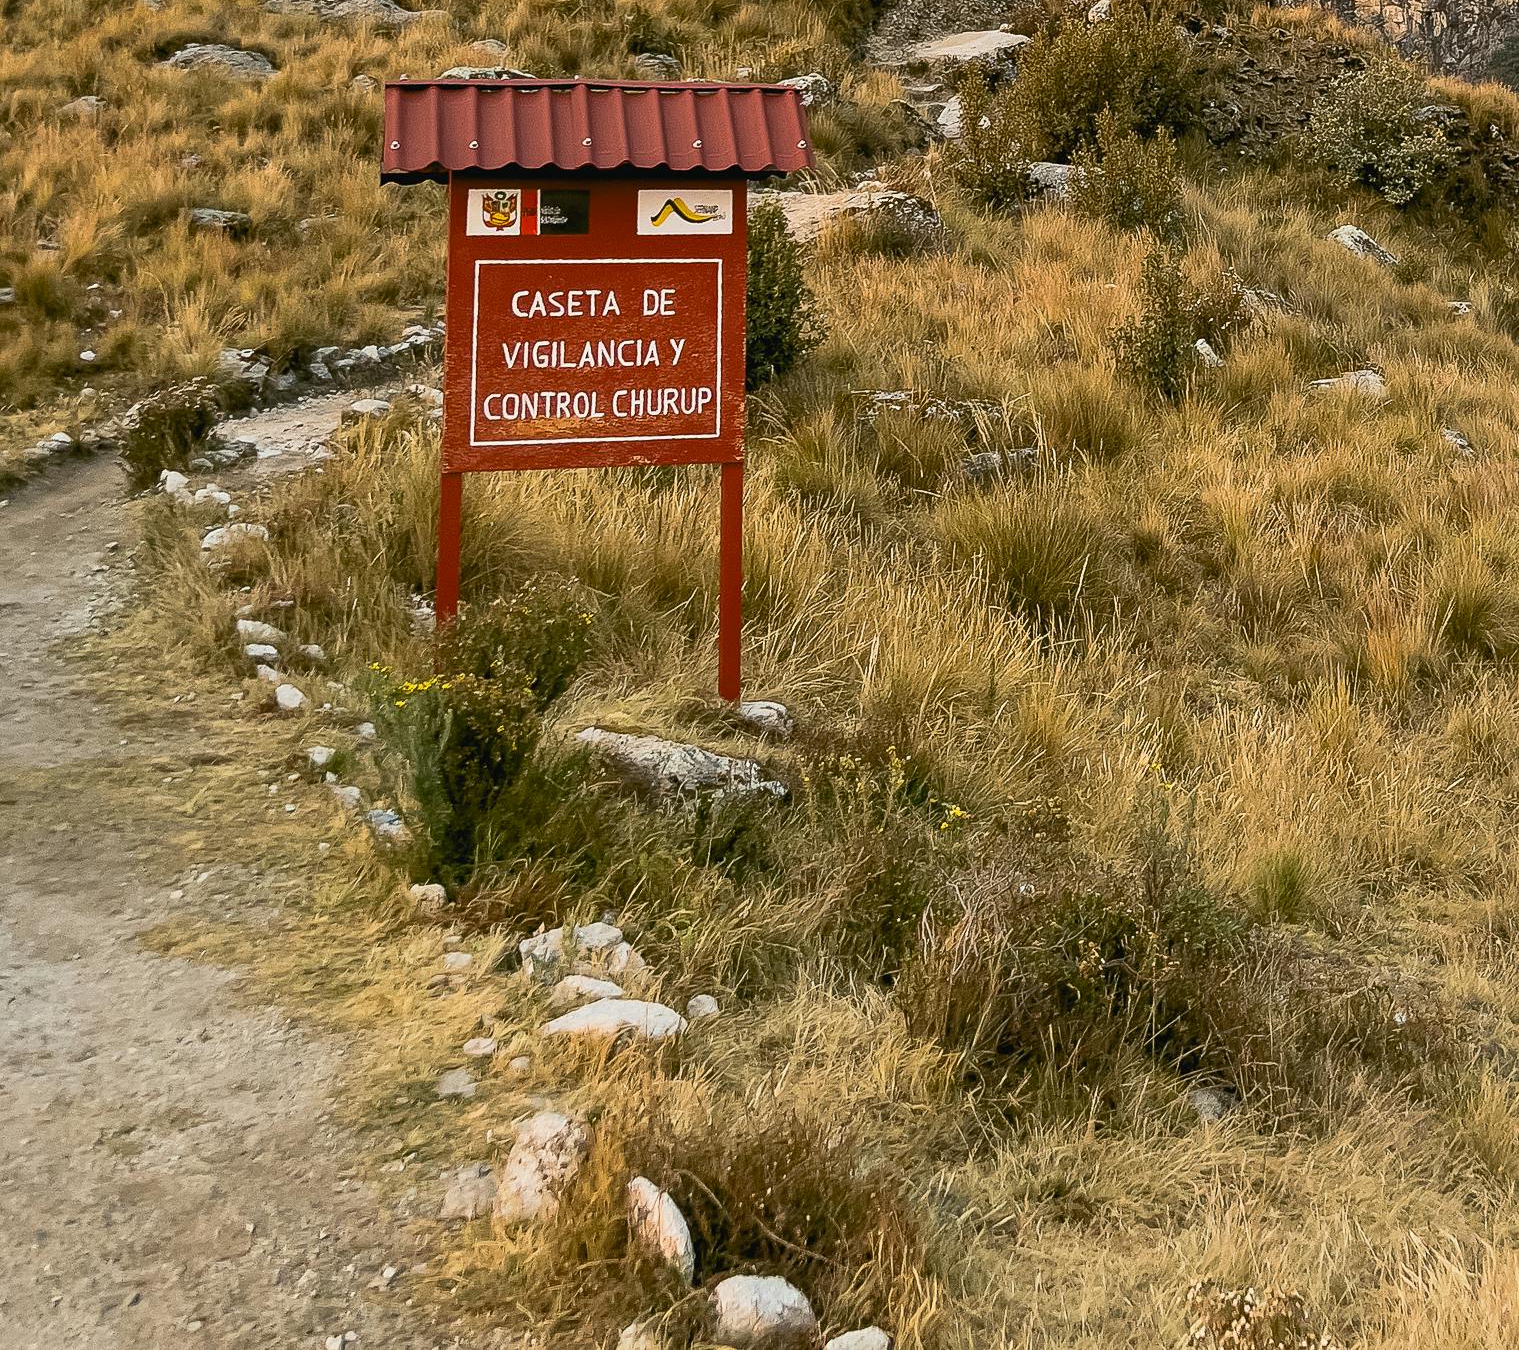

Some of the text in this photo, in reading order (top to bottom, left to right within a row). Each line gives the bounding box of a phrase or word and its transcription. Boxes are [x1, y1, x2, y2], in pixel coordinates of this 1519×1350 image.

[511, 289, 676, 318] CASETA DE
[502, 338, 686, 369] VIGILANCIA Y
[483, 387, 713, 420] CONTROL CHURUP
